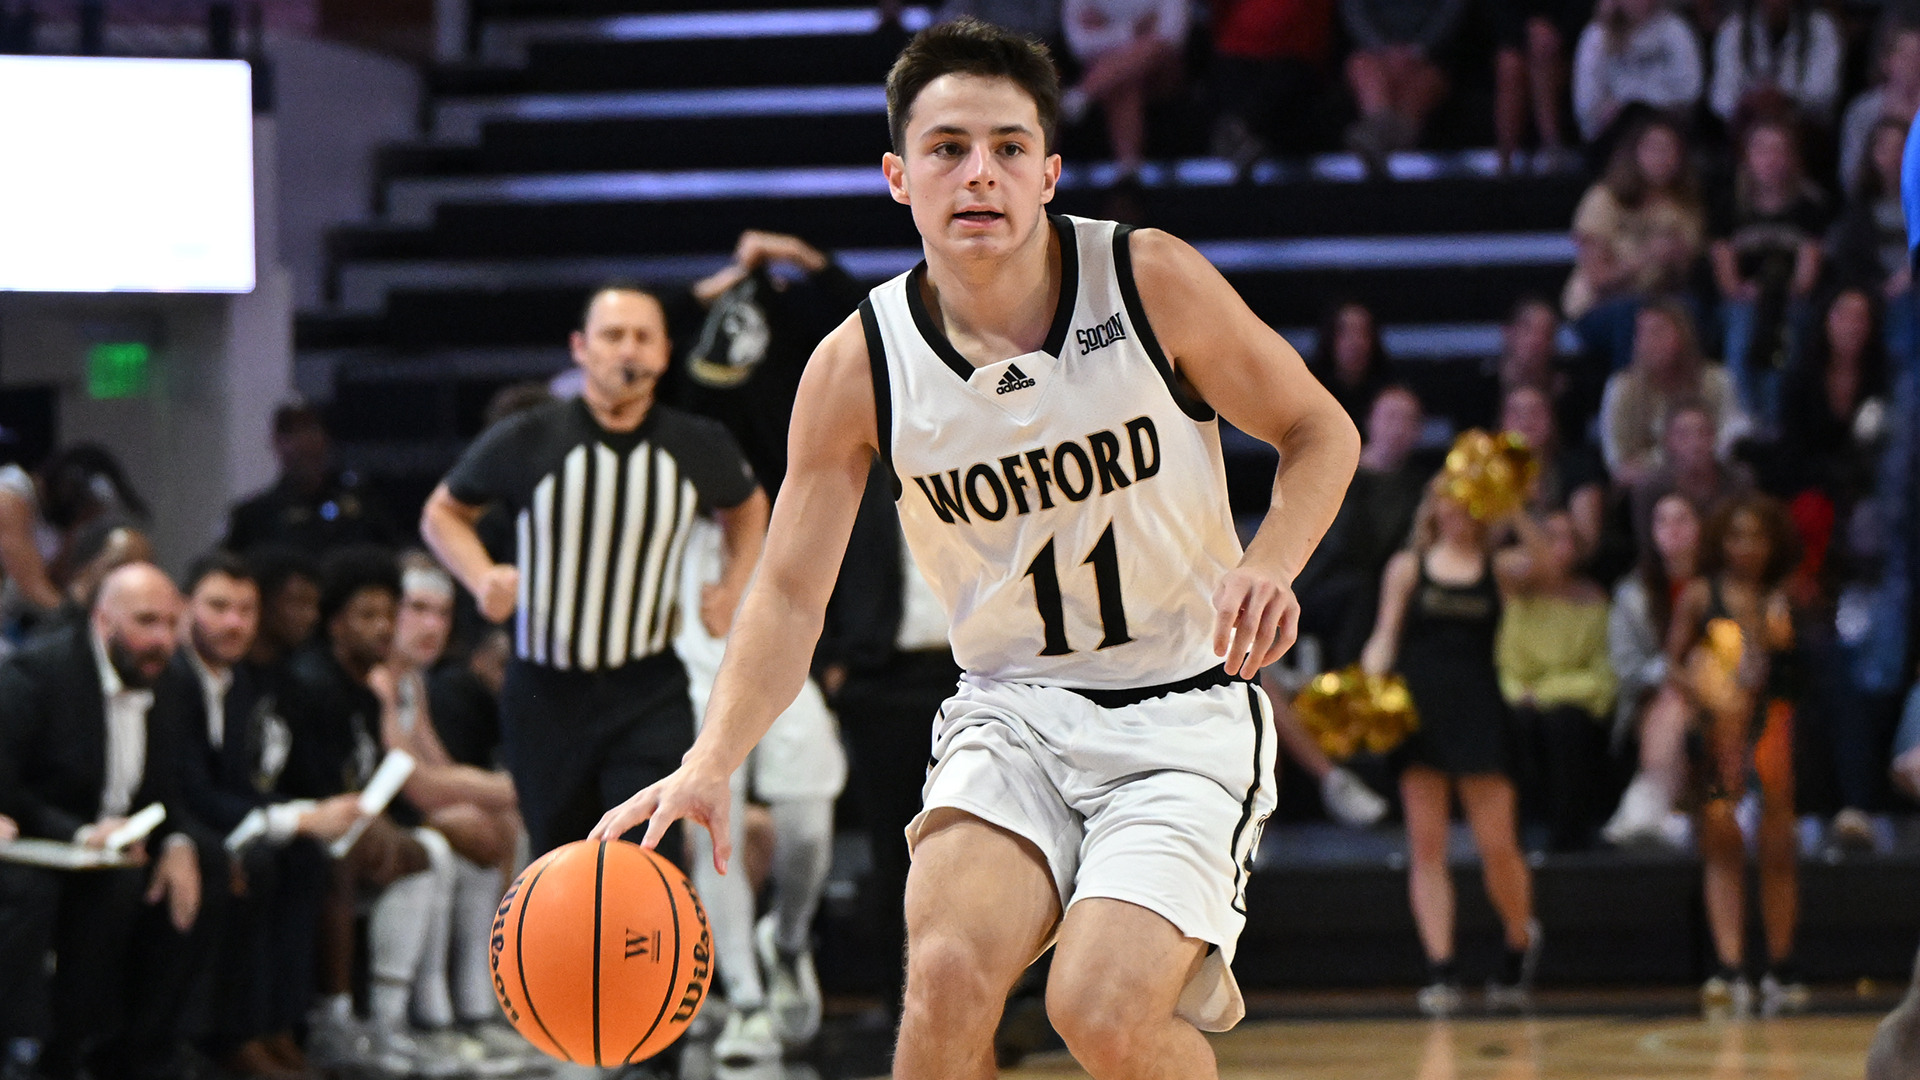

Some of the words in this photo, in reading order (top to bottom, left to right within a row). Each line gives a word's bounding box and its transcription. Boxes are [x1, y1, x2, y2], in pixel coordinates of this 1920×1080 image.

[996, 378, 1036, 395] adidas
[912, 415, 1161, 525] WOFFORD
[1021, 516, 1139, 657] 11
